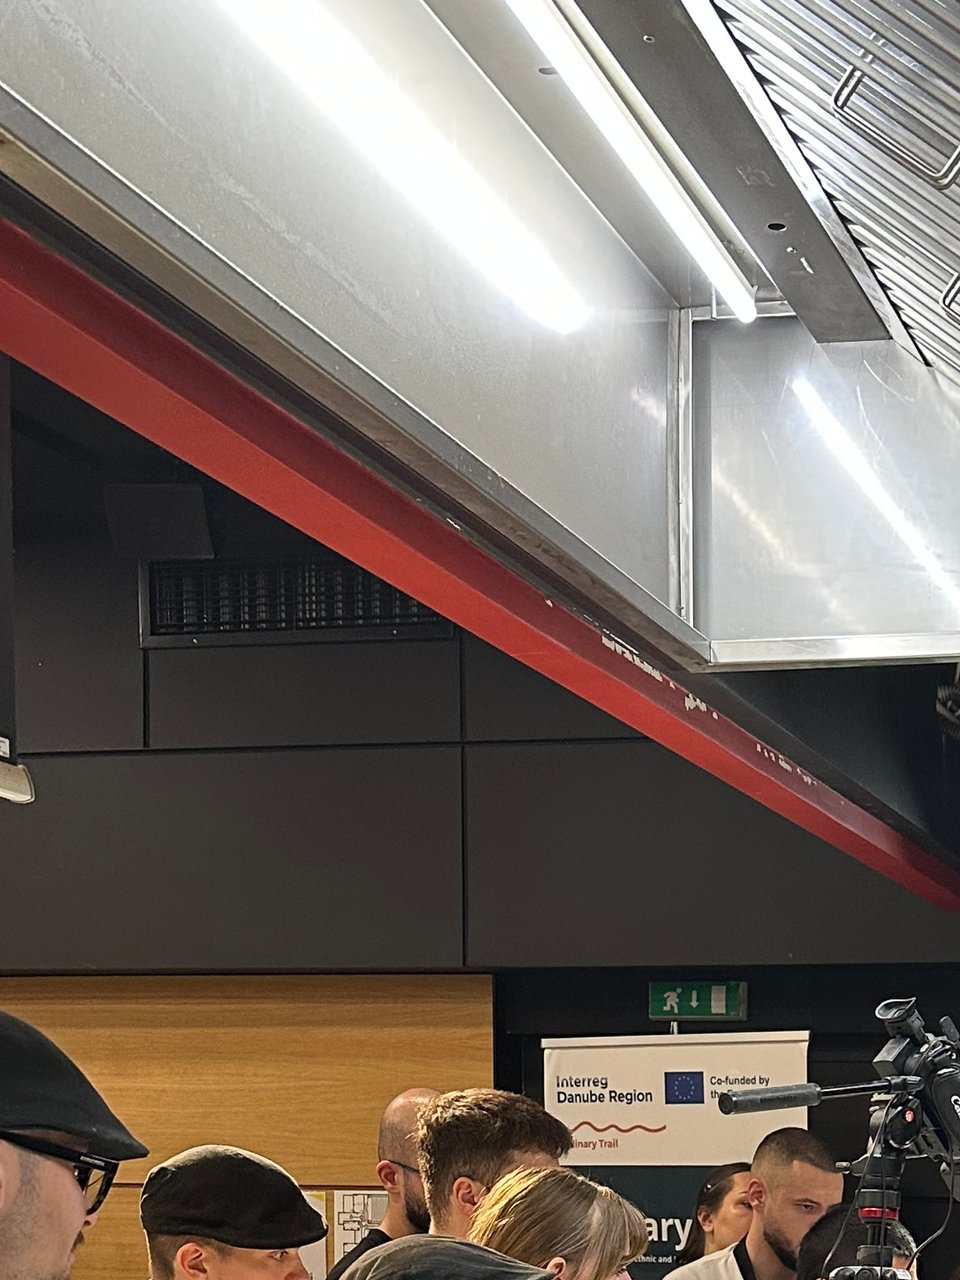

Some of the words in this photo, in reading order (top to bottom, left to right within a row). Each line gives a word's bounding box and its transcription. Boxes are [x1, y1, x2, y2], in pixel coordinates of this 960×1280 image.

[556, 1076, 608, 1089] Interreg
[710, 1076, 756, 1085] Co-funded
[759, 1076, 770, 1087] by
[557, 1091, 605, 1103] Danube
[609, 1089, 653, 1104] Region
[598, 1139, 619, 1148] Trail
[646, 1217, 693, 1251] ary
[658, 1255, 673, 1263] and
